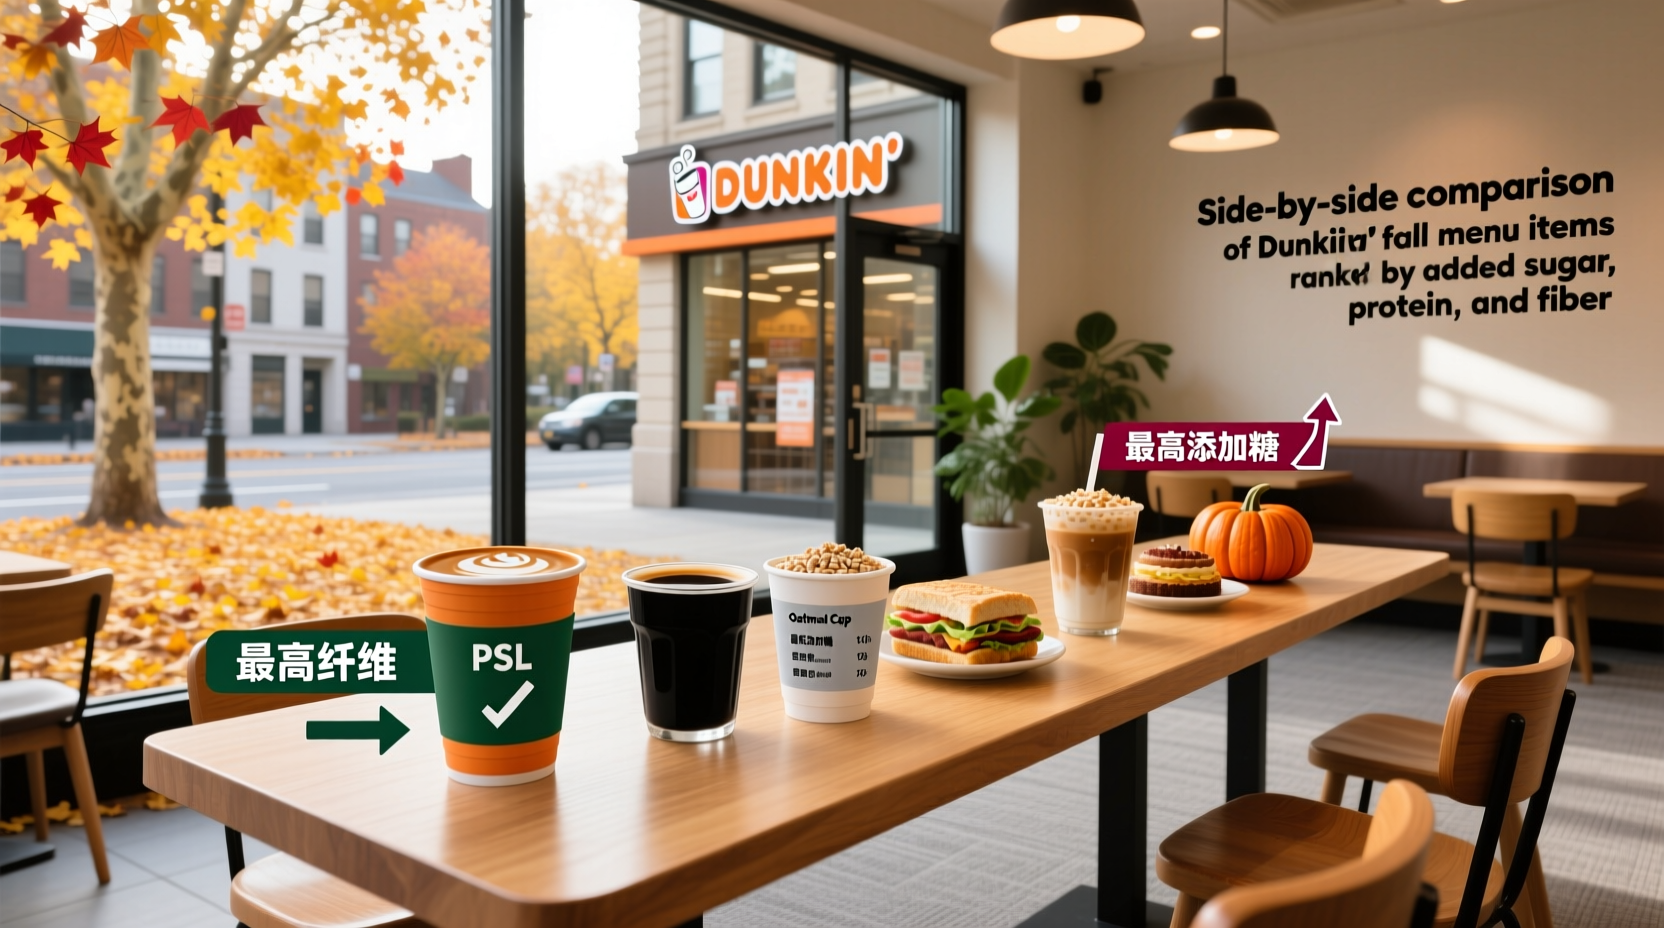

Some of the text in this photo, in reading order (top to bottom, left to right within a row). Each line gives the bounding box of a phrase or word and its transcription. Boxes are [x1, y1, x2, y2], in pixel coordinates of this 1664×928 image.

[713, 136, 901, 210] DUNKIN'
[1197, 166, 1614, 227] Side-by-side comparison
[1223, 235, 1251, 260] of
[1381, 221, 1429, 251] fall
[1438, 223, 1520, 247] menu
[1529, 213, 1615, 241] items
[1381, 259, 1416, 291] by
[1422, 252, 1515, 282] added
[1524, 253, 1616, 283] sugar,
[1348, 284, 1615, 326] protein, and fiber
[829, 613, 852, 628] Cup
[472, 643, 533, 672] PSL
